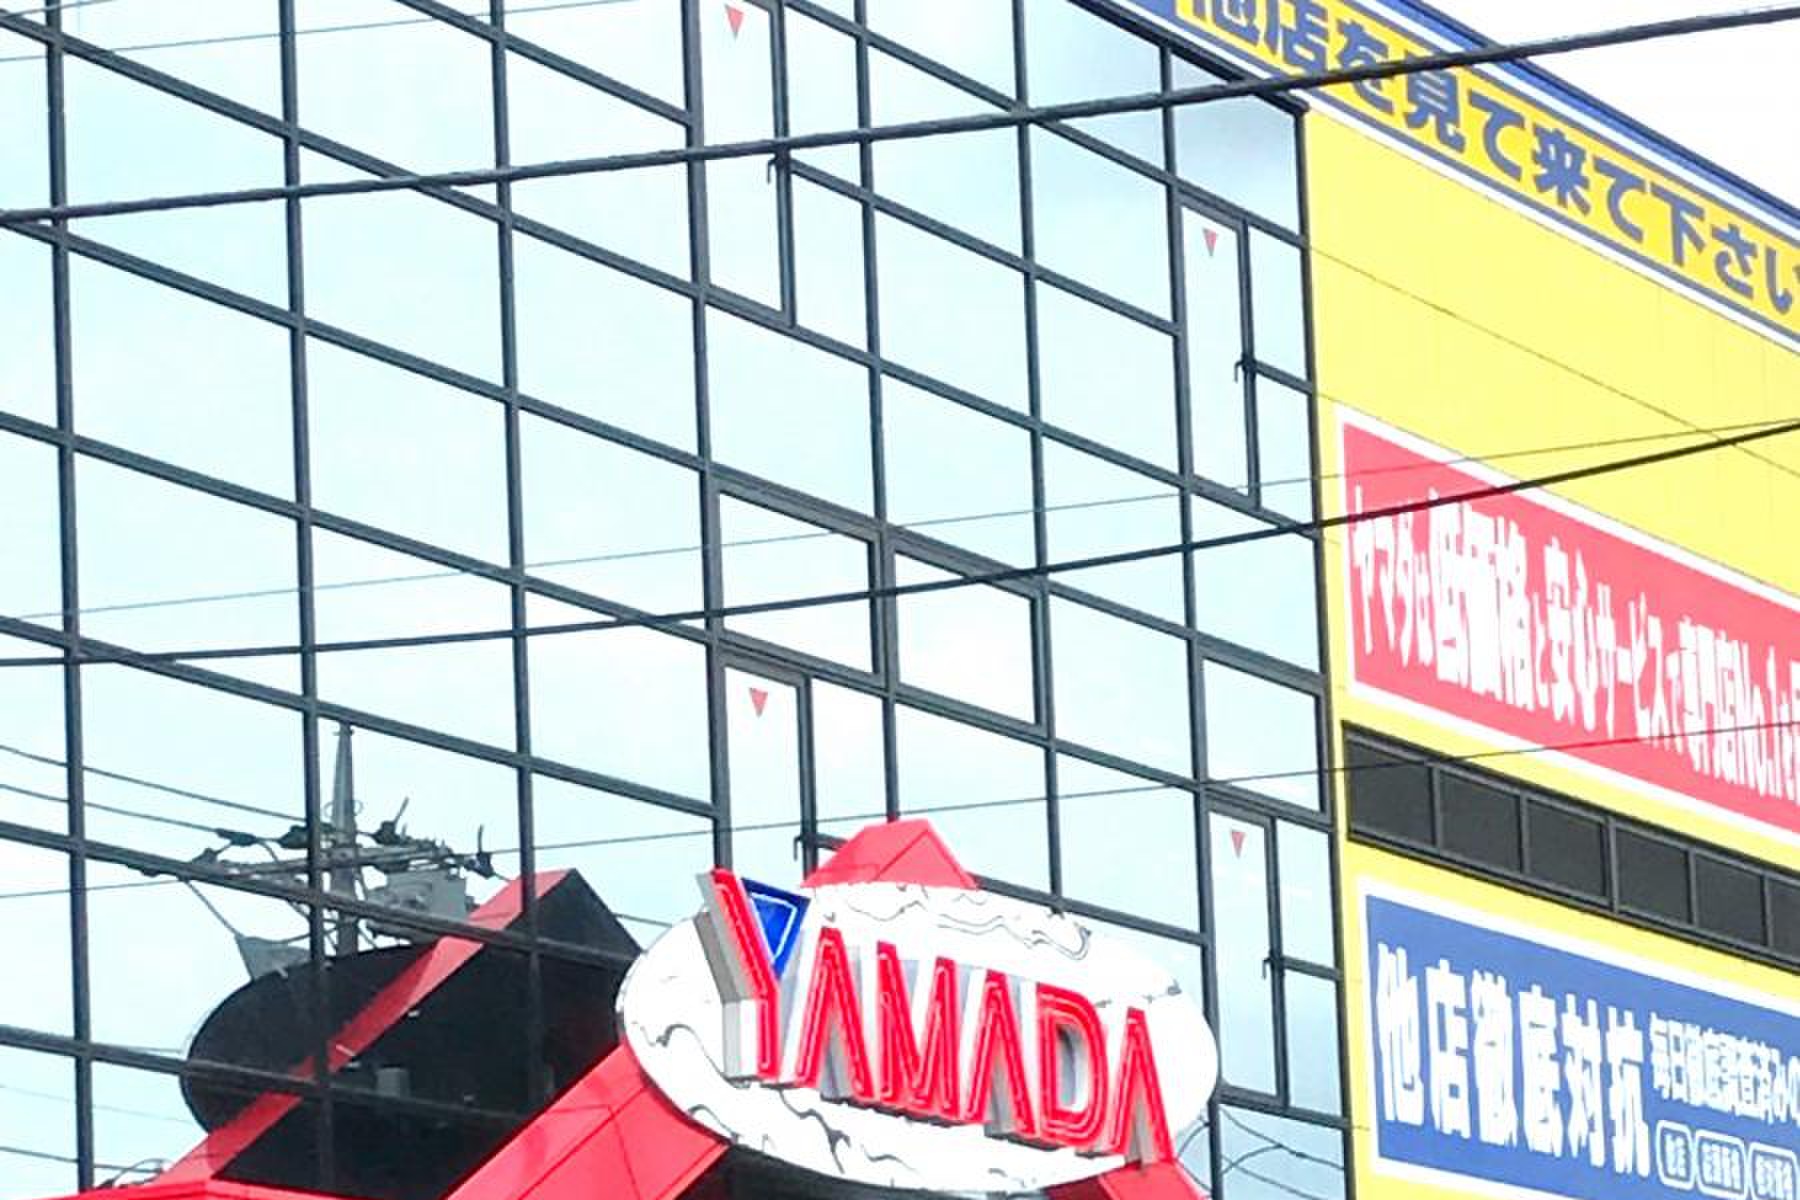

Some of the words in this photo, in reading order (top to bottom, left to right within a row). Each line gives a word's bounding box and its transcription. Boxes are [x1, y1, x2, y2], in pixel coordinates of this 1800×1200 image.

[698, 868, 1175, 1162] YAMADA
[1377, 943, 1650, 1178] 他店徹底対抗
